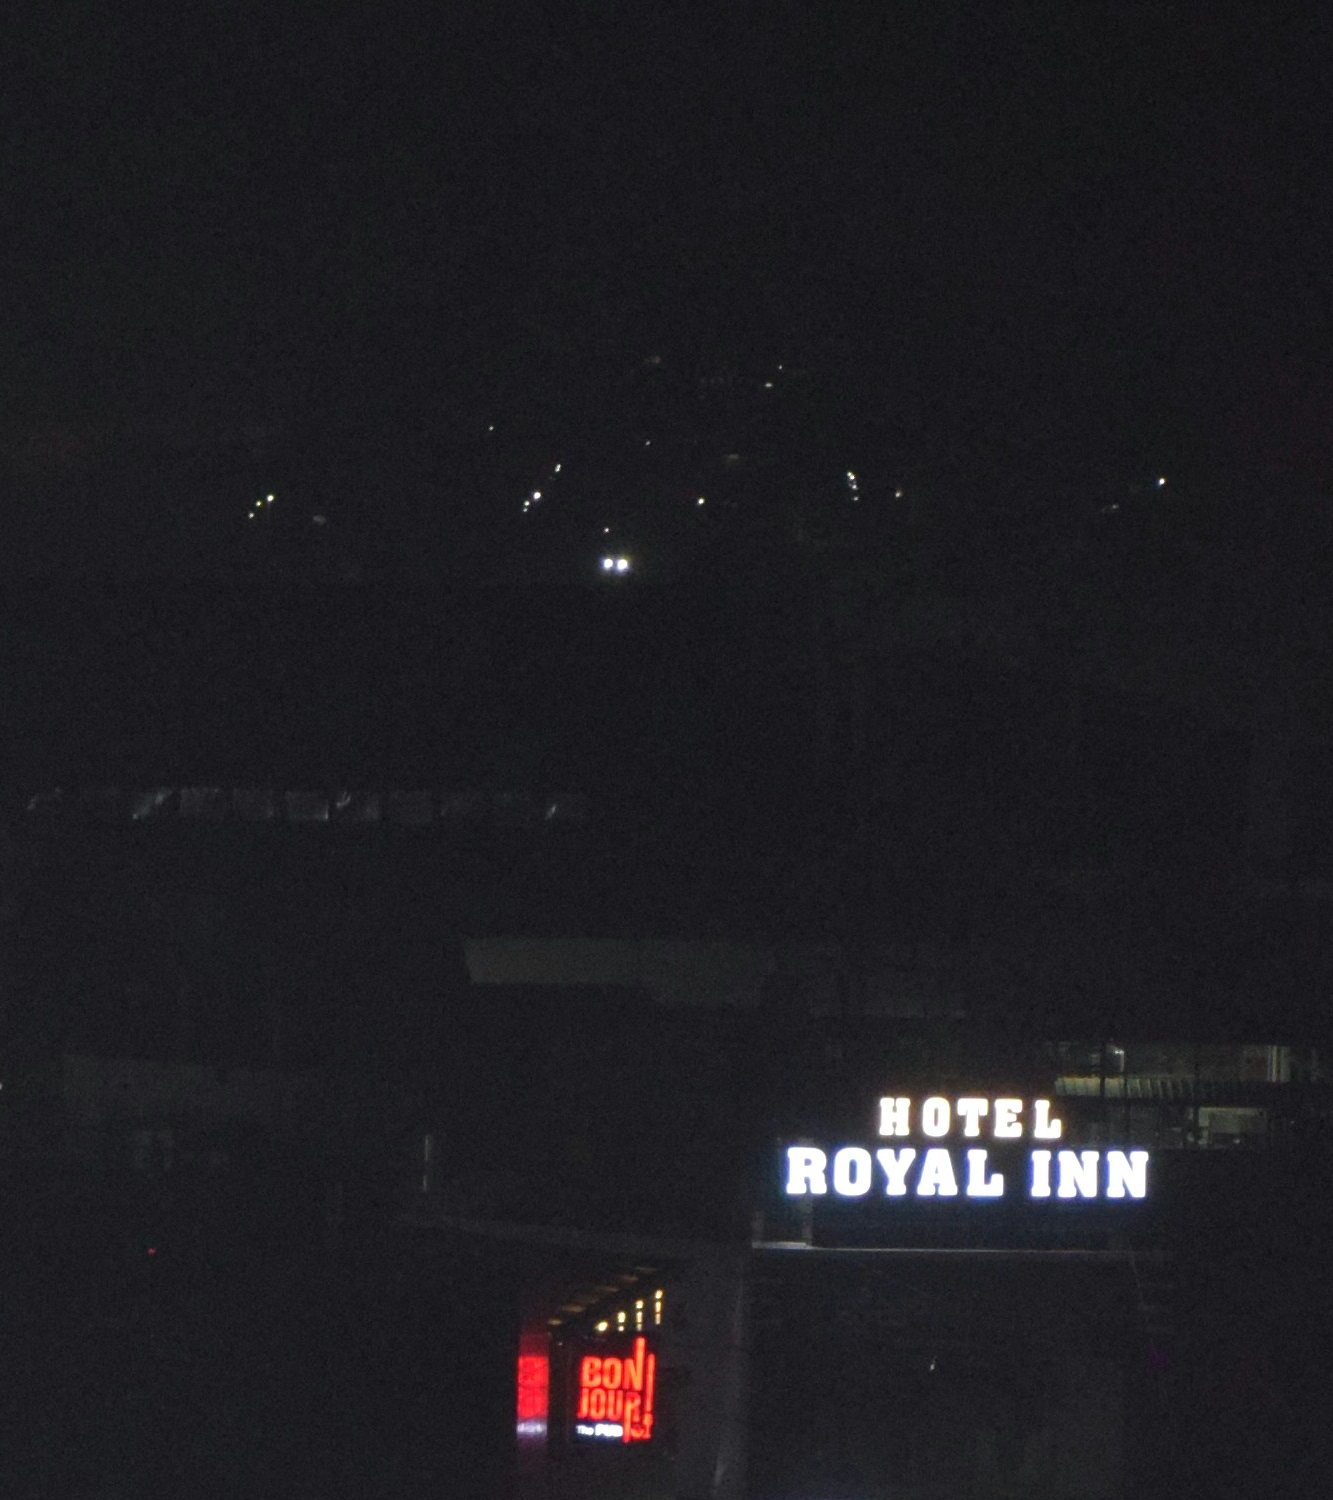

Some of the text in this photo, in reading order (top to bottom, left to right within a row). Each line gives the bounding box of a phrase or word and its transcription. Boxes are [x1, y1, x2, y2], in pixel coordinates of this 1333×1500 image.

[878, 1097, 1063, 1140] HOTEL
[786, 1147, 1150, 1199] ROYAL INN
